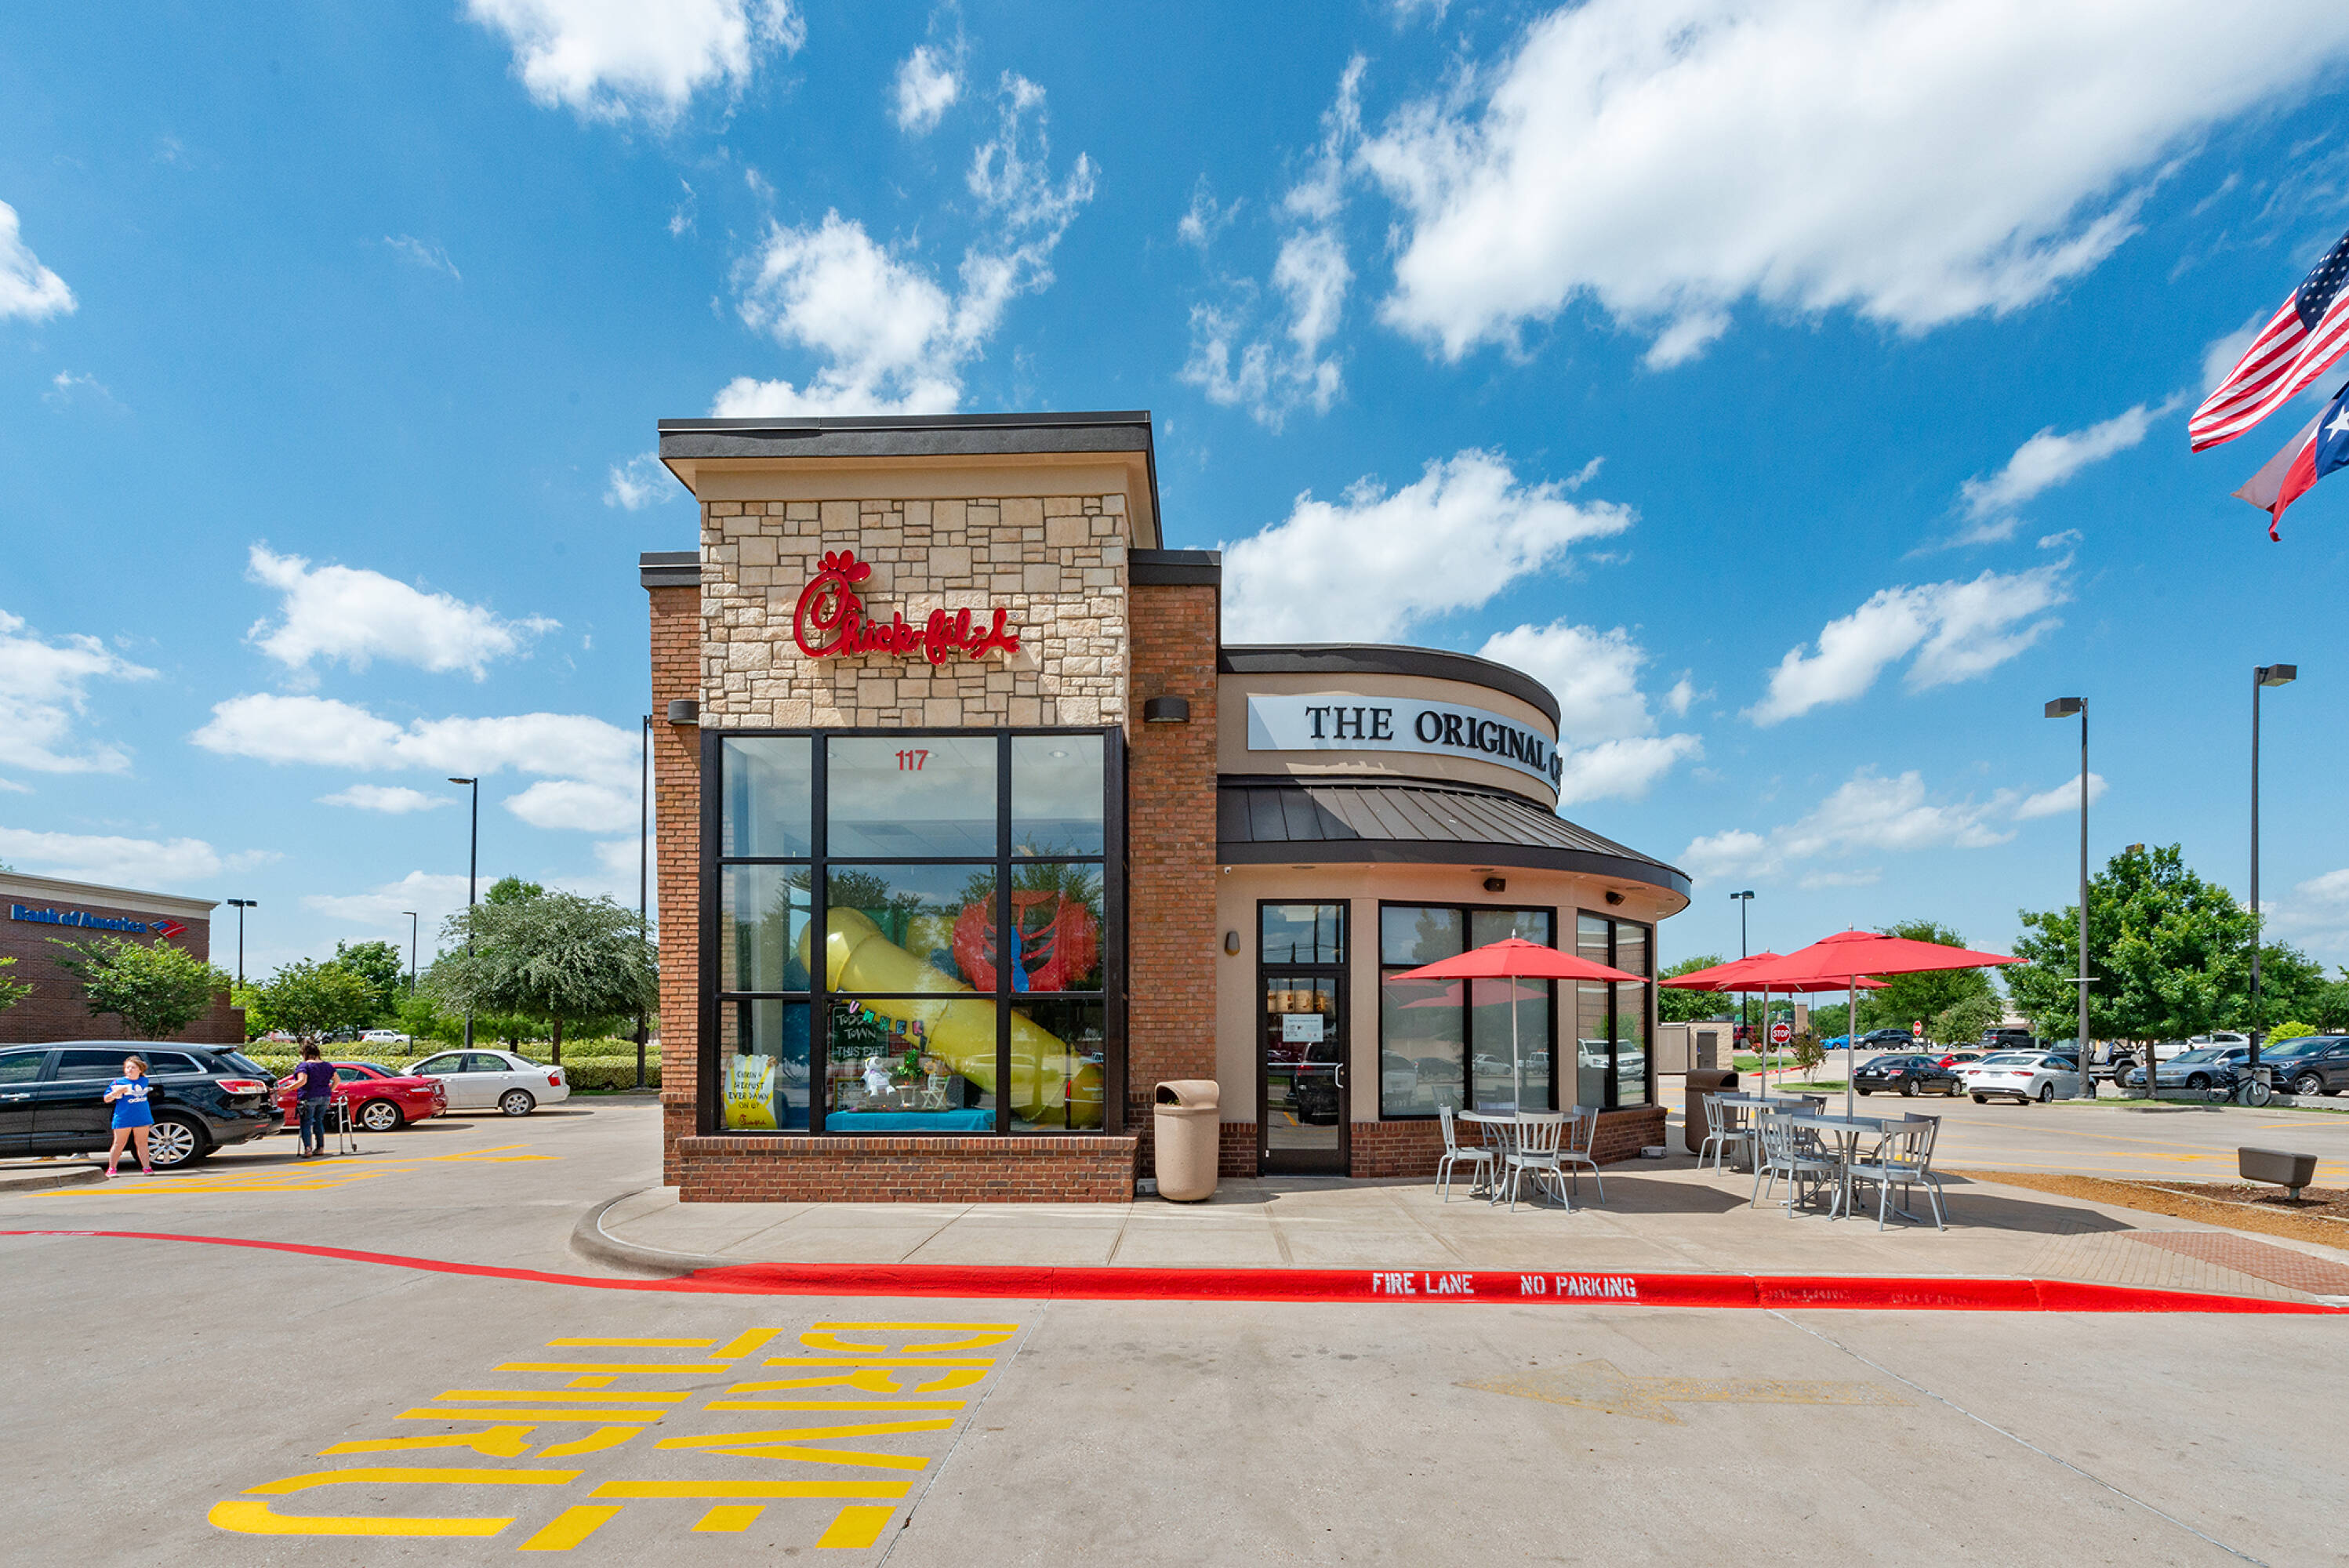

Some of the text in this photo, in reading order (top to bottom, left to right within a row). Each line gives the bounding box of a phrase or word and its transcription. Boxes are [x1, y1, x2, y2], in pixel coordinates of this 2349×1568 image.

[793, 550, 1020, 666] Chick-fil-A
[1305, 705, 1394, 740] THE
[1416, 710, 1547, 772] ORIGINAL
[895, 750, 929, 771] 117
[11, 904, 147, 934] Bank of America
[848, 1000, 924, 1036] UMMER
[1773, 1029, 1789, 1038] STOP
[837, 1045, 885, 1058] THIS EXIT
[1372, 1272, 1637, 1298] FIRE LANE NO PARKING
[208, 1327, 783, 1537] THRU
[517, 1322, 1019, 1551] DRIVE
